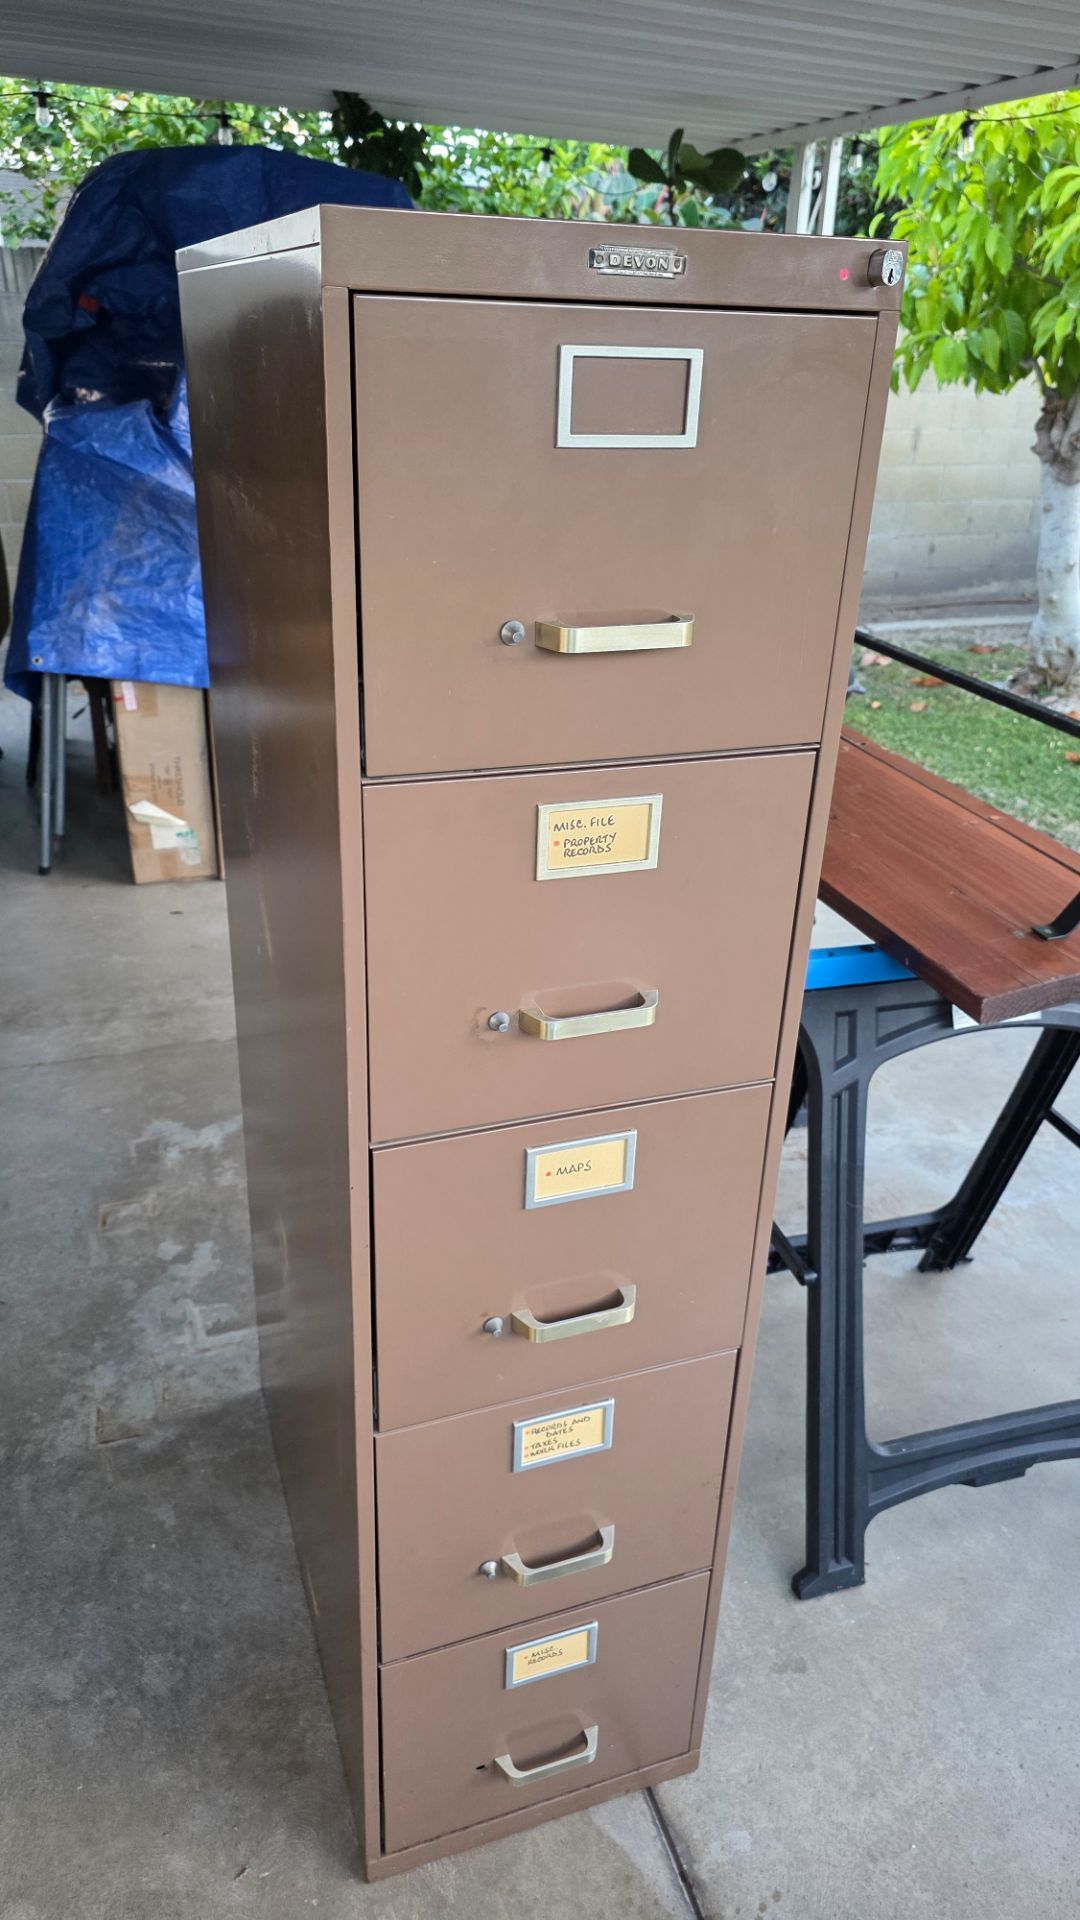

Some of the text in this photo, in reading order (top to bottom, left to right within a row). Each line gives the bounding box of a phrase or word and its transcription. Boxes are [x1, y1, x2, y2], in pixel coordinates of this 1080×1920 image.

[609, 254, 669, 270] DEVON
[553, 815, 616, 832] MISC. FILE
[563, 832, 617, 849] PROPERTY
[563, 843, 612, 858] RECORDS
[556, 1160, 592, 1176] MAPS
[531, 1416, 591, 1435] RECORDS AND
[546, 1425, 574, 1438] DATES
[531, 1437, 558, 1450] TAXES
[557, 1438, 581, 1450] FILES
[528, 1649, 563, 1665] RECORDS
